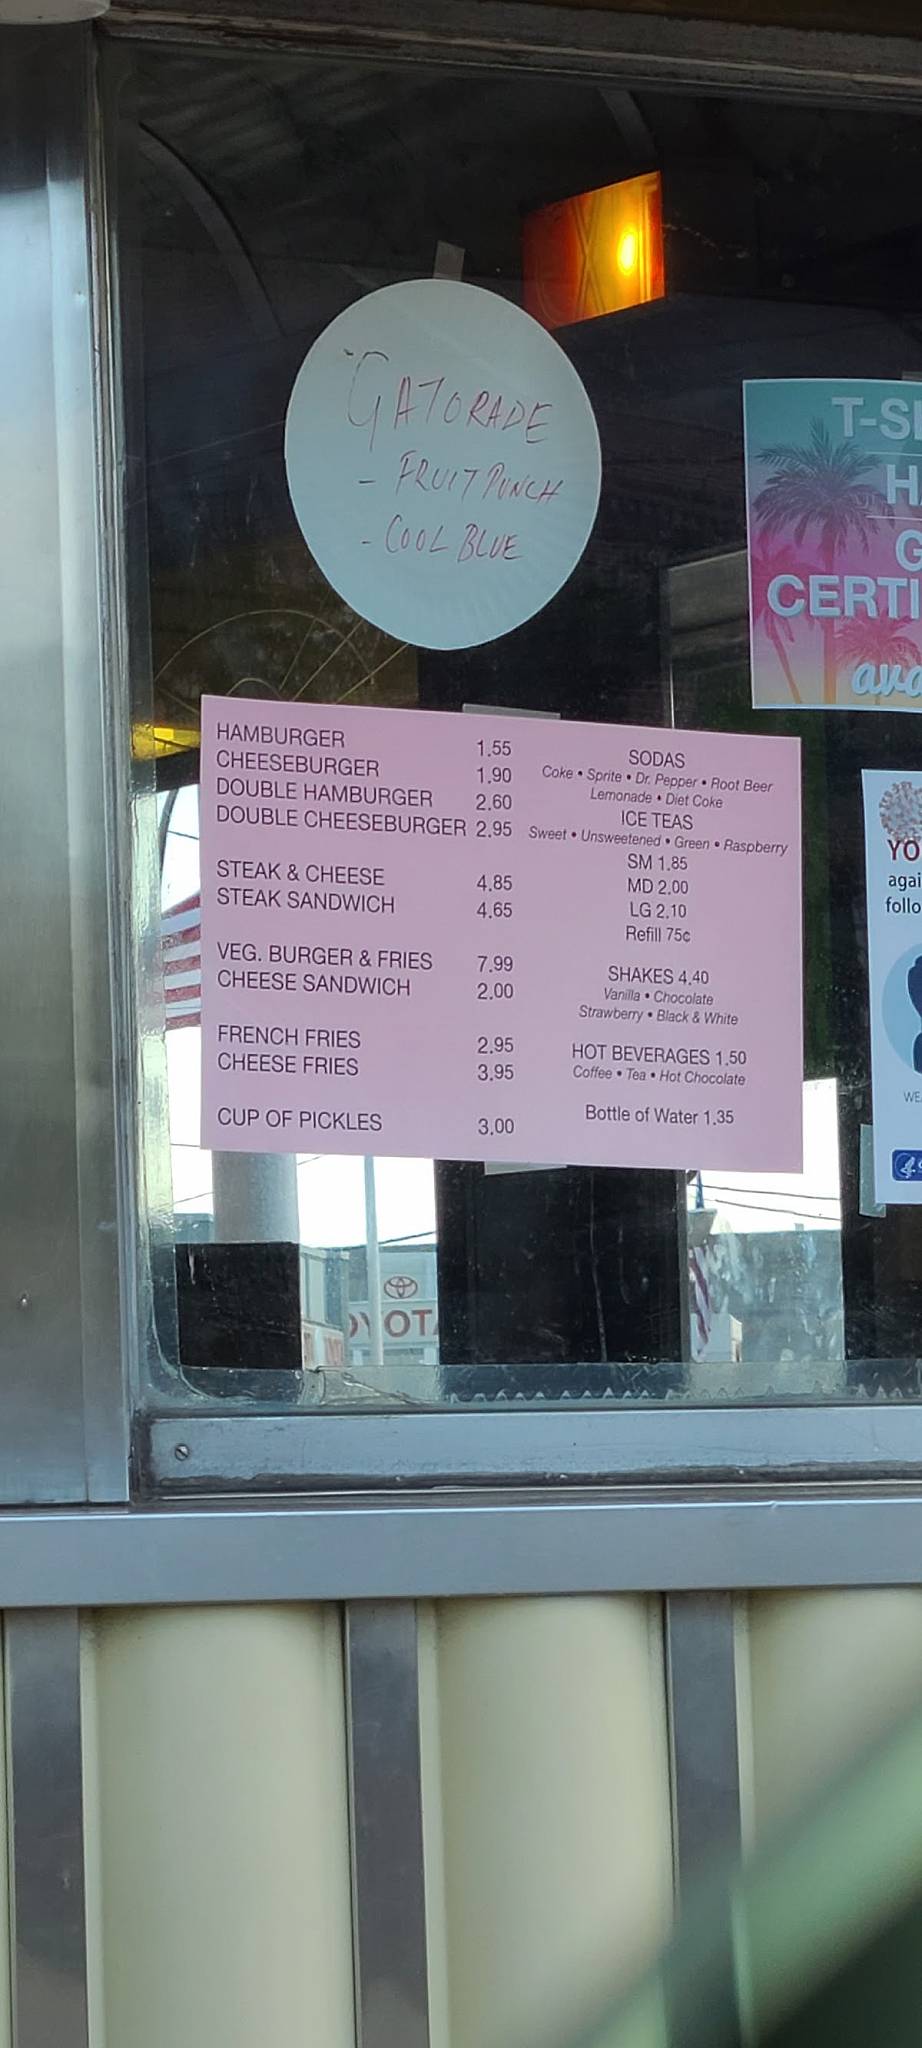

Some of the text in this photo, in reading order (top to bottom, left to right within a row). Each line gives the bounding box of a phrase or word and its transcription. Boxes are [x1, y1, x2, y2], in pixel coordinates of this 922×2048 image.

[344, 349, 553, 451] GATORADE
[396, 450, 479, 499] FRUIT
[482, 462, 564, 503] PUNCH
[886, 464, 922, 506] H
[386, 514, 448, 553] COOL
[457, 523, 523, 563] BLUE
[767, 575, 919, 619] CERTI
[218, 723, 344, 748] HAMBURGER
[477, 740, 511, 757] 1.55
[217, 750, 379, 777] CHEESEBURGER
[629, 750, 685, 768] SODAS
[477, 767, 511, 784] 1.90
[542, 765, 773, 792] Coke Sprite Dr. Pepper Root Beer
[217, 777, 432, 807] DOUBLE HAMBURGER
[591, 788, 723, 808] Lemonade Diet Coke
[476, 794, 512, 811] 2.60
[217, 805, 466, 836] DOUBLE CHEESEBURGER
[476, 821, 512, 838] 2.95
[622, 810, 693, 830] ICE TEAS
[529, 826, 788, 856] Sweet Unsweetened Green Raspberry
[888, 840, 920, 861] YO
[628, 853, 687, 871] SM 1.85
[217, 860, 384, 885] STEAK & CHEESE
[889, 873, 921, 891] agai
[477, 875, 512, 892] 4.85
[628, 878, 688, 895] MD 2.00
[217, 887, 394, 913] STEAK SANDWICH
[630, 901, 686, 919] LG 2.10
[886, 897, 921, 913] follo
[477, 902, 512, 919] 4.65
[626, 925, 661, 942] Refill
[217, 942, 432, 970] VEG. BURGER & FRIES
[478, 956, 513, 973] 7.99
[218, 970, 410, 996] CHEESE SANDWICH
[608, 966, 709, 985] SHAKES 4.40
[478, 983, 513, 1000] 2.00
[605, 987, 713, 1005] Vanilla Chocolate
[579, 1005, 738, 1025] Strawberry Black & White
[218, 1025, 360, 1048] FRENCH FRIES
[478, 1037, 513, 1054] 2.95
[218, 1052, 358, 1076] CHEESE FRIES
[572, 1043, 746, 1066] HOT BEVERAGES 1.50
[478, 1064, 513, 1081] 3.95
[573, 1065, 746, 1085] Coffee Tea Hot Chocolate
[218, 1108, 382, 1131] CUP OF PICKLES
[586, 1104, 734, 1125] Bottle of Water 1.35
[478, 1118, 514, 1136] 3.00
